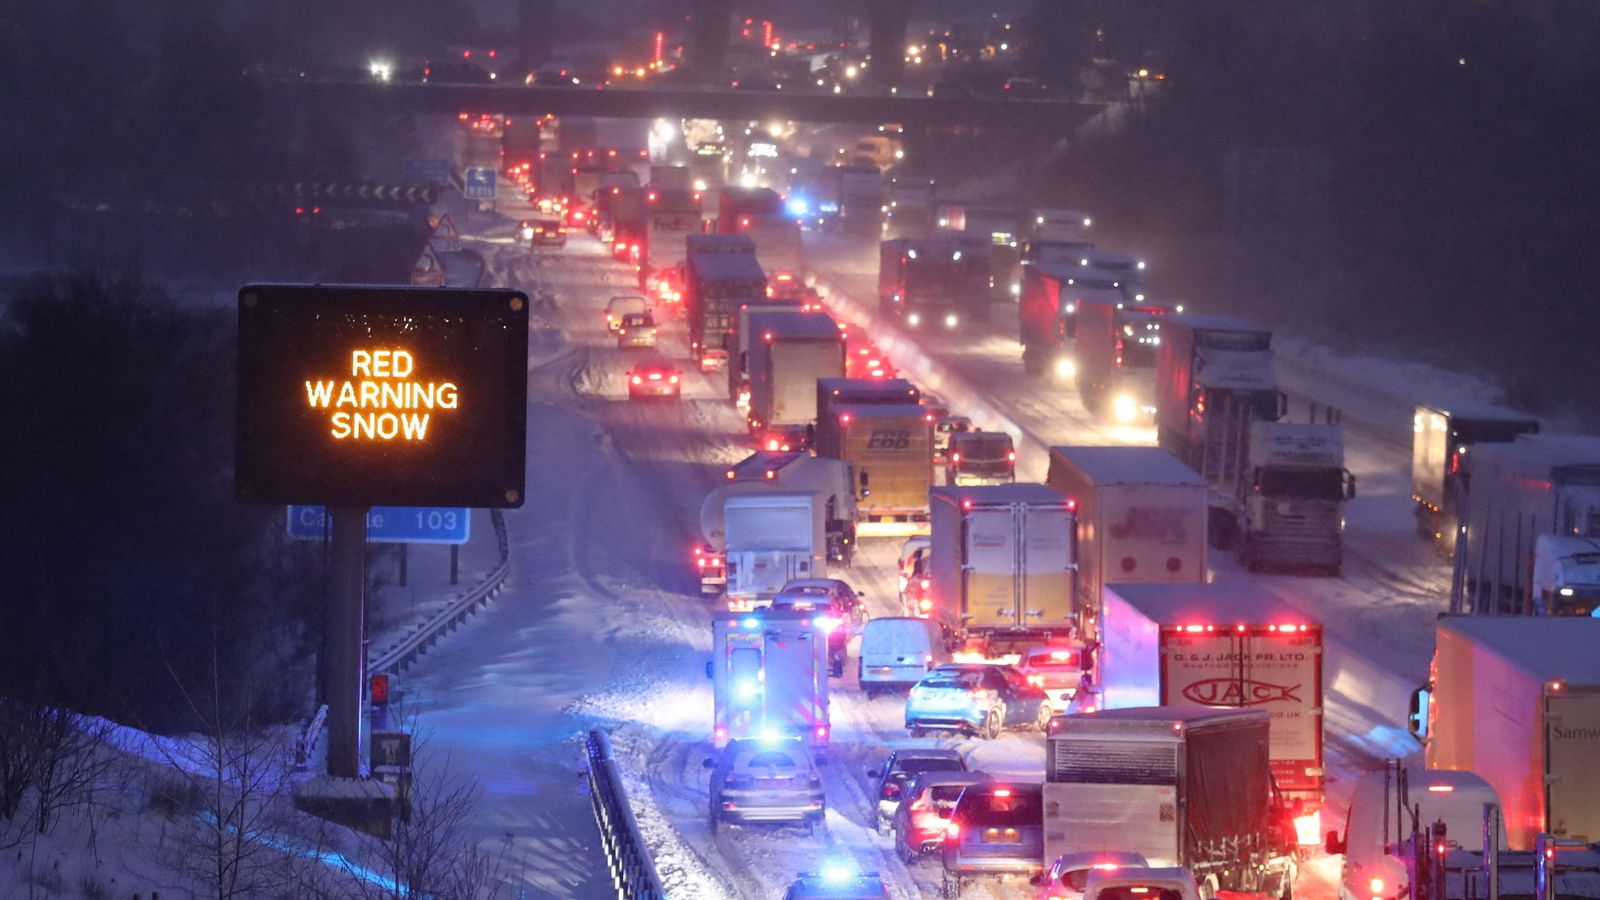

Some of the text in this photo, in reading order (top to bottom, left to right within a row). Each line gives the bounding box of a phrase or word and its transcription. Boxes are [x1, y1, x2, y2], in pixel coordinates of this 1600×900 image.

[351, 350, 413, 378] RED
[305, 381, 458, 409] WARNING
[331, 412, 430, 440] SNOW
[415, 511, 457, 531] 103
[1197, 683, 1302, 703] JACK
